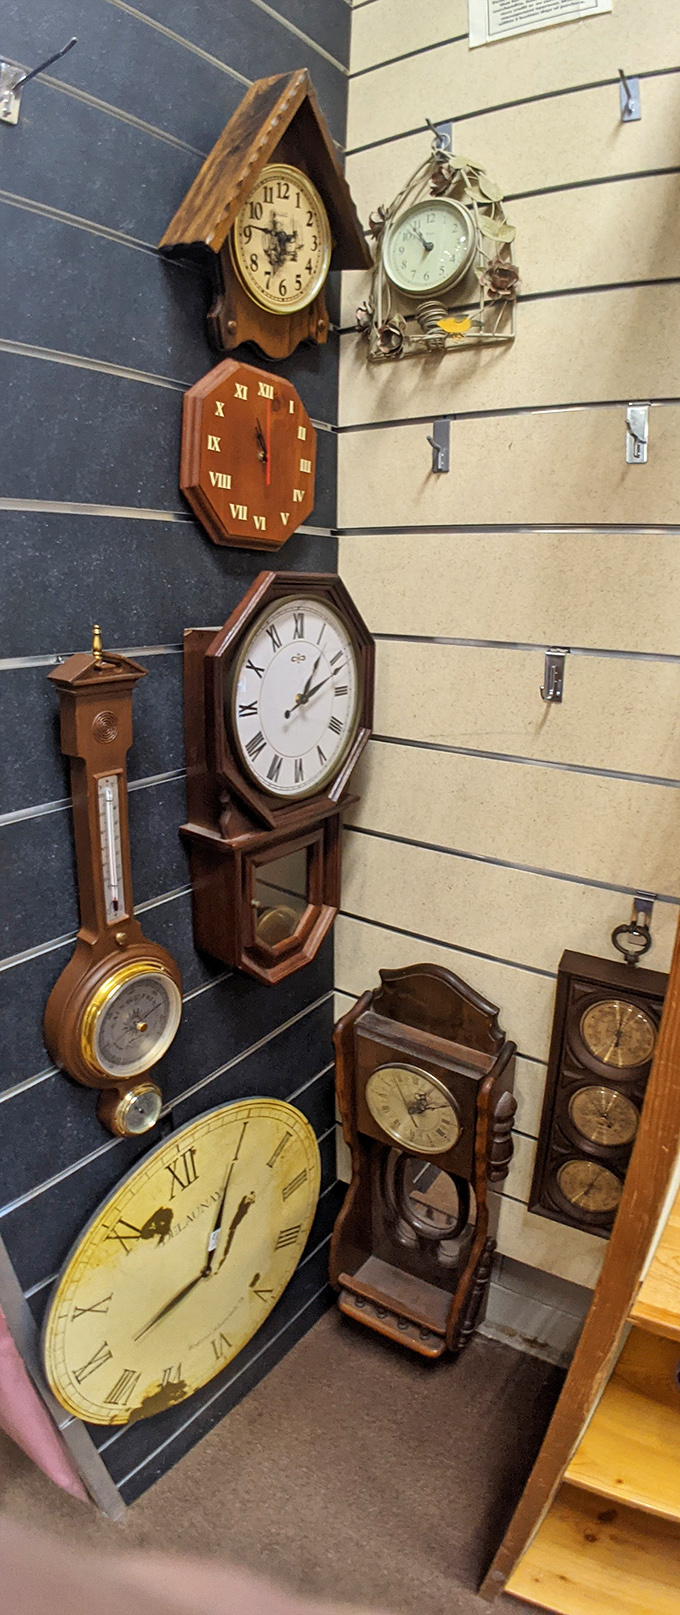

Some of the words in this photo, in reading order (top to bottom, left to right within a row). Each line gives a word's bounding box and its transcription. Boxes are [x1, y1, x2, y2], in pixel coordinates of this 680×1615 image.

[263, 186, 274, 204] 11
[277, 182, 289, 200] 12
[295, 192, 301, 208] 1
[249, 202, 263, 220] 10
[306, 211, 313, 227] 2
[427, 214, 435, 223] 12
[443, 216, 447, 224] 1
[452, 224, 458, 233] 2
[244, 226, 252, 244] 9
[311, 236, 318, 251] 3
[402, 232, 412, 241] 10
[250, 254, 258, 272] 8
[305, 258, 312, 275] 4
[402, 260, 407, 270] 8
[449, 255, 455, 263] 4
[411, 270, 416, 279] 7
[424, 272, 430, 281] 6
[439, 266, 445, 276] 5
[264, 272, 271, 290] 7
[279, 279, 287, 297] 6
[295, 274, 302, 291] 5
[234, 383, 248, 400] XI
[258, 382, 274, 400] XII
[215, 401, 225, 417] X
[289, 400, 294, 414] I
[298, 426, 307, 441] II
[208, 436, 221, 452] IX
[300, 459, 311, 473] III
[209, 471, 231, 489] VIII
[293, 489, 305, 502] IV
[230, 503, 248, 521] VII
[280, 512, 289, 526] V
[253, 516, 266, 531] VI
[293, 613, 304, 639] XII
[317, 623, 326, 645] I
[266, 624, 282, 652] XI
[330, 650, 344, 665] II
[246, 659, 264, 678] X
[335, 685, 348, 697] III
[239, 701, 258, 718] IX
[328, 716, 343, 735] IIII
[245, 731, 267, 762] VIII
[317, 745, 327, 766] V
[266, 754, 283, 783] VII
[294, 758, 304, 783] VI
[267, 1131, 292, 1168] II
[164, 1146, 199, 1202] XII
[282, 1168, 308, 1202] III
[102, 1215, 142, 1256] XI
[253, 1289, 274, 1303] V
[71, 1293, 114, 1322] X
[210, 1332, 233, 1361] VI
[72, 1341, 113, 1385] IX
[104, 1368, 142, 1406] VIII
